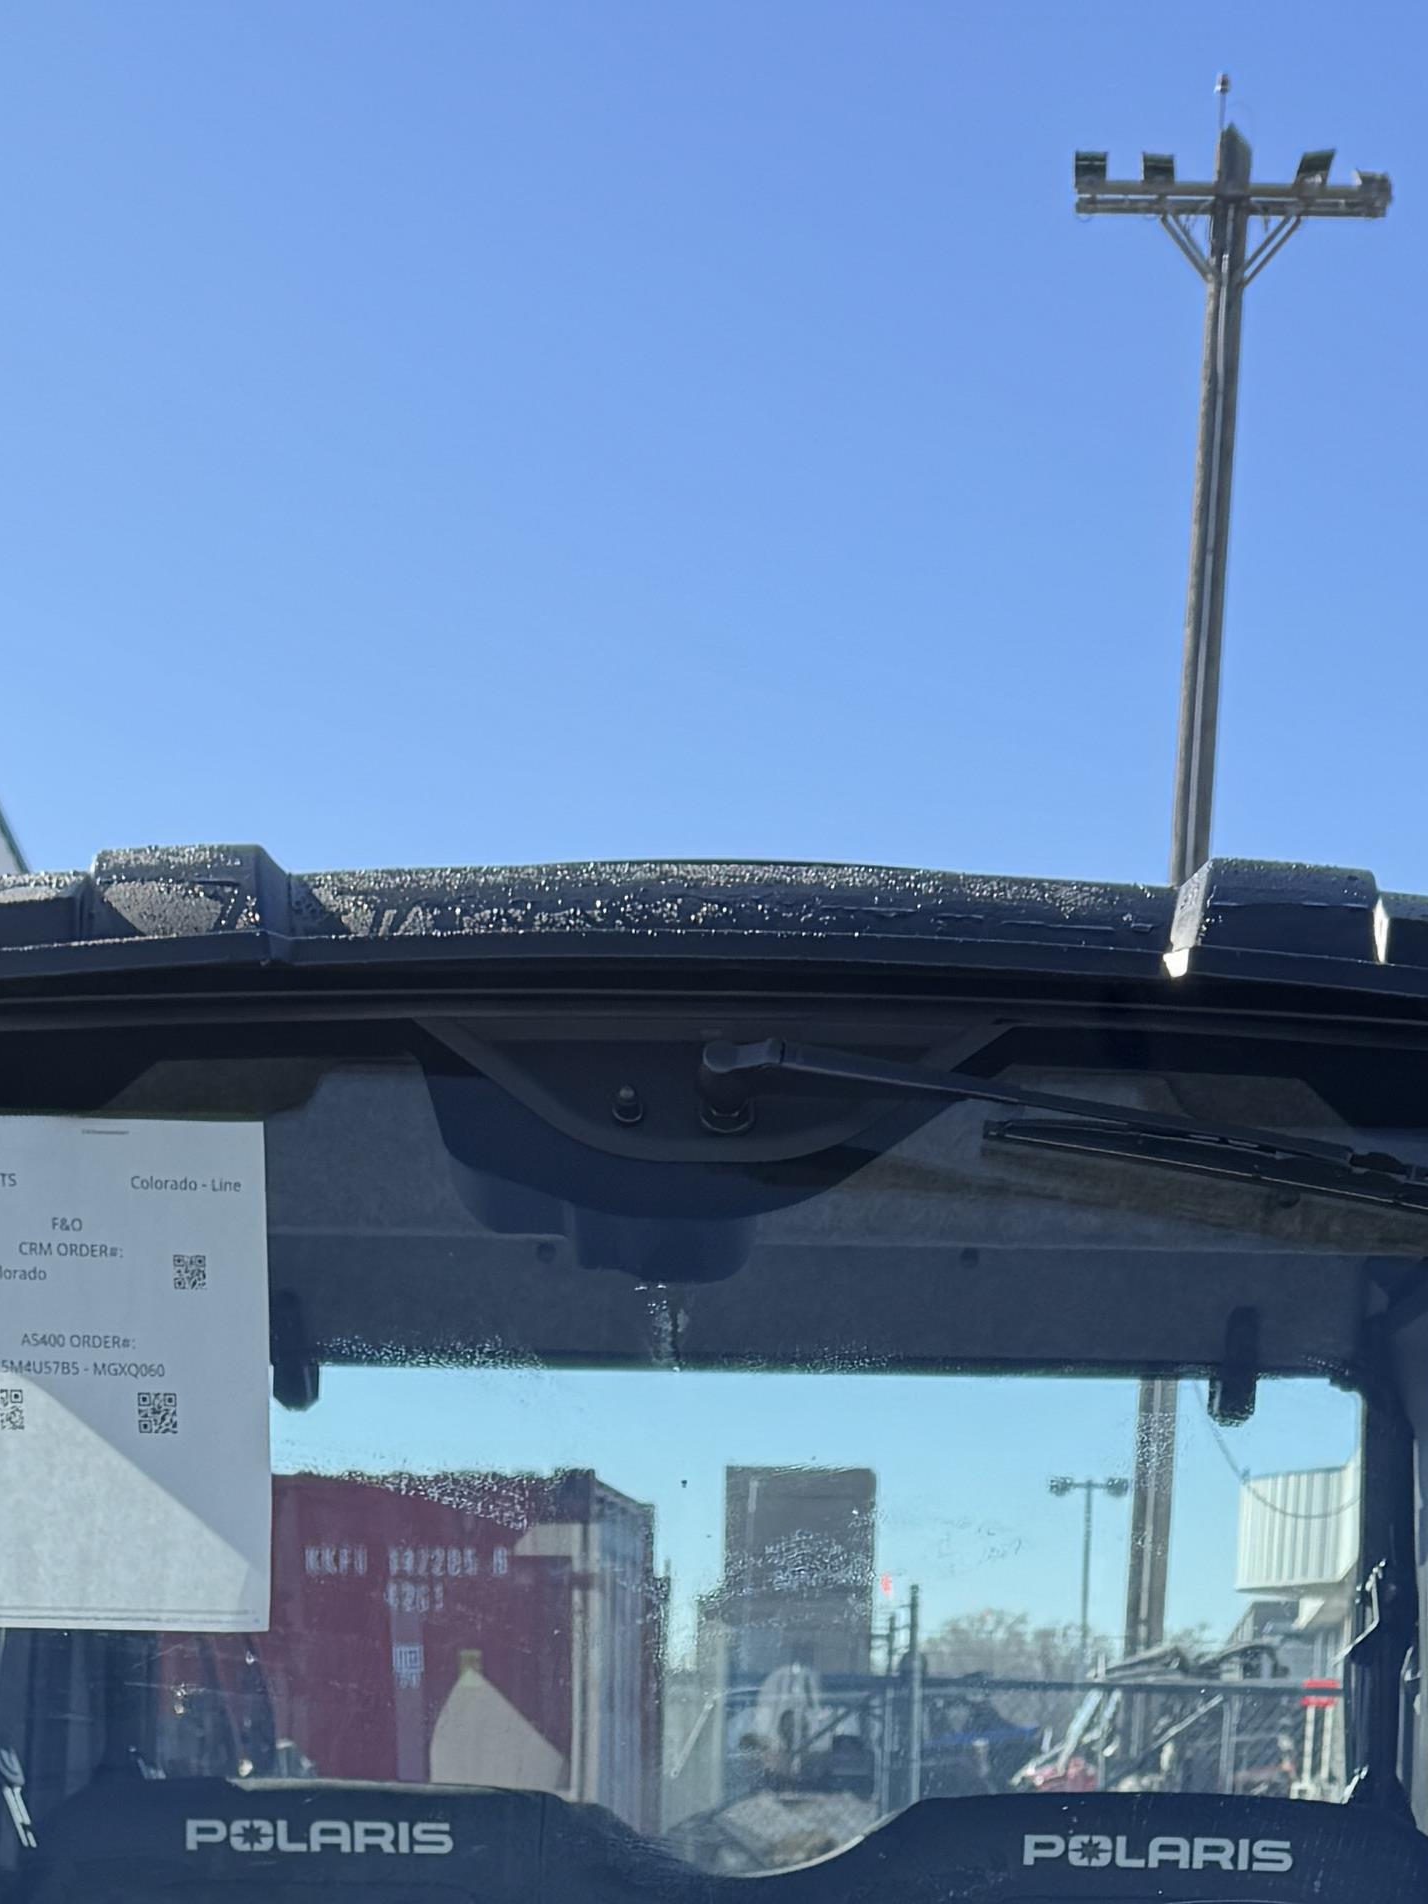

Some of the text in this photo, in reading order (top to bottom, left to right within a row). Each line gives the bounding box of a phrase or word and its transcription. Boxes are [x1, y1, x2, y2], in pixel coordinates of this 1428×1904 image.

[130, 1175, 198, 1192] Colorado
[211, 1178, 242, 1193] Line
[51, 1216, 83, 1233] F&O
[18, 1241, 124, 1258] CRM ORDER#:
[21, 1333, 136, 1349] AS400 ORDER#:
[185, 1818, 454, 1855] POLARIS
[1022, 1834, 1294, 1872] POLARIS
